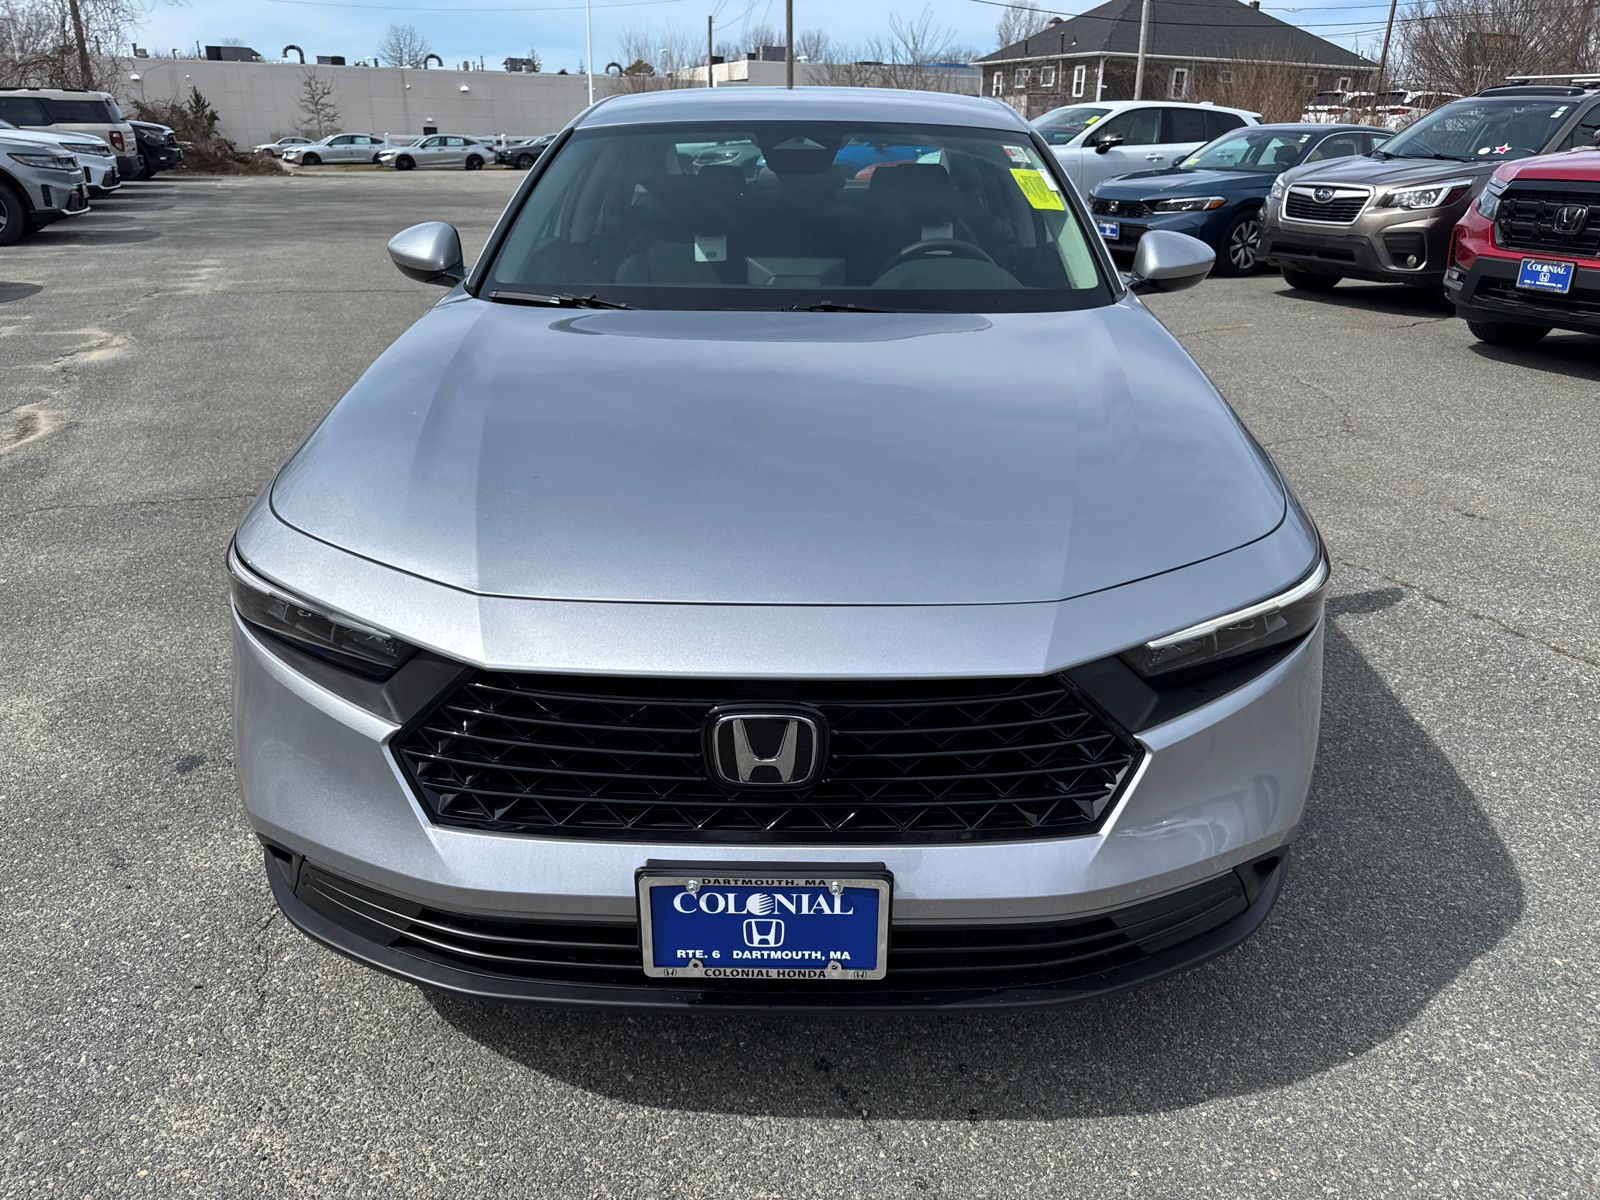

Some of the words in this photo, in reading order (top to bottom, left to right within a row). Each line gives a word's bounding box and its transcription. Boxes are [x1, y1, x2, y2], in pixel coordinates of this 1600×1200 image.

[1527, 262, 1567, 275] COLONIAL
[701, 878, 800, 887] DARTMOUTH,
[673, 891, 854, 916] COLONIAL
[676, 949, 709, 959] RTE.
[711, 950, 721, 959] 6
[732, 950, 826, 961] DARTMOUTH,
[829, 950, 851, 960] MA
[703, 968, 773, 978] COLONIAL
[776, 969, 827, 979] HONDA
